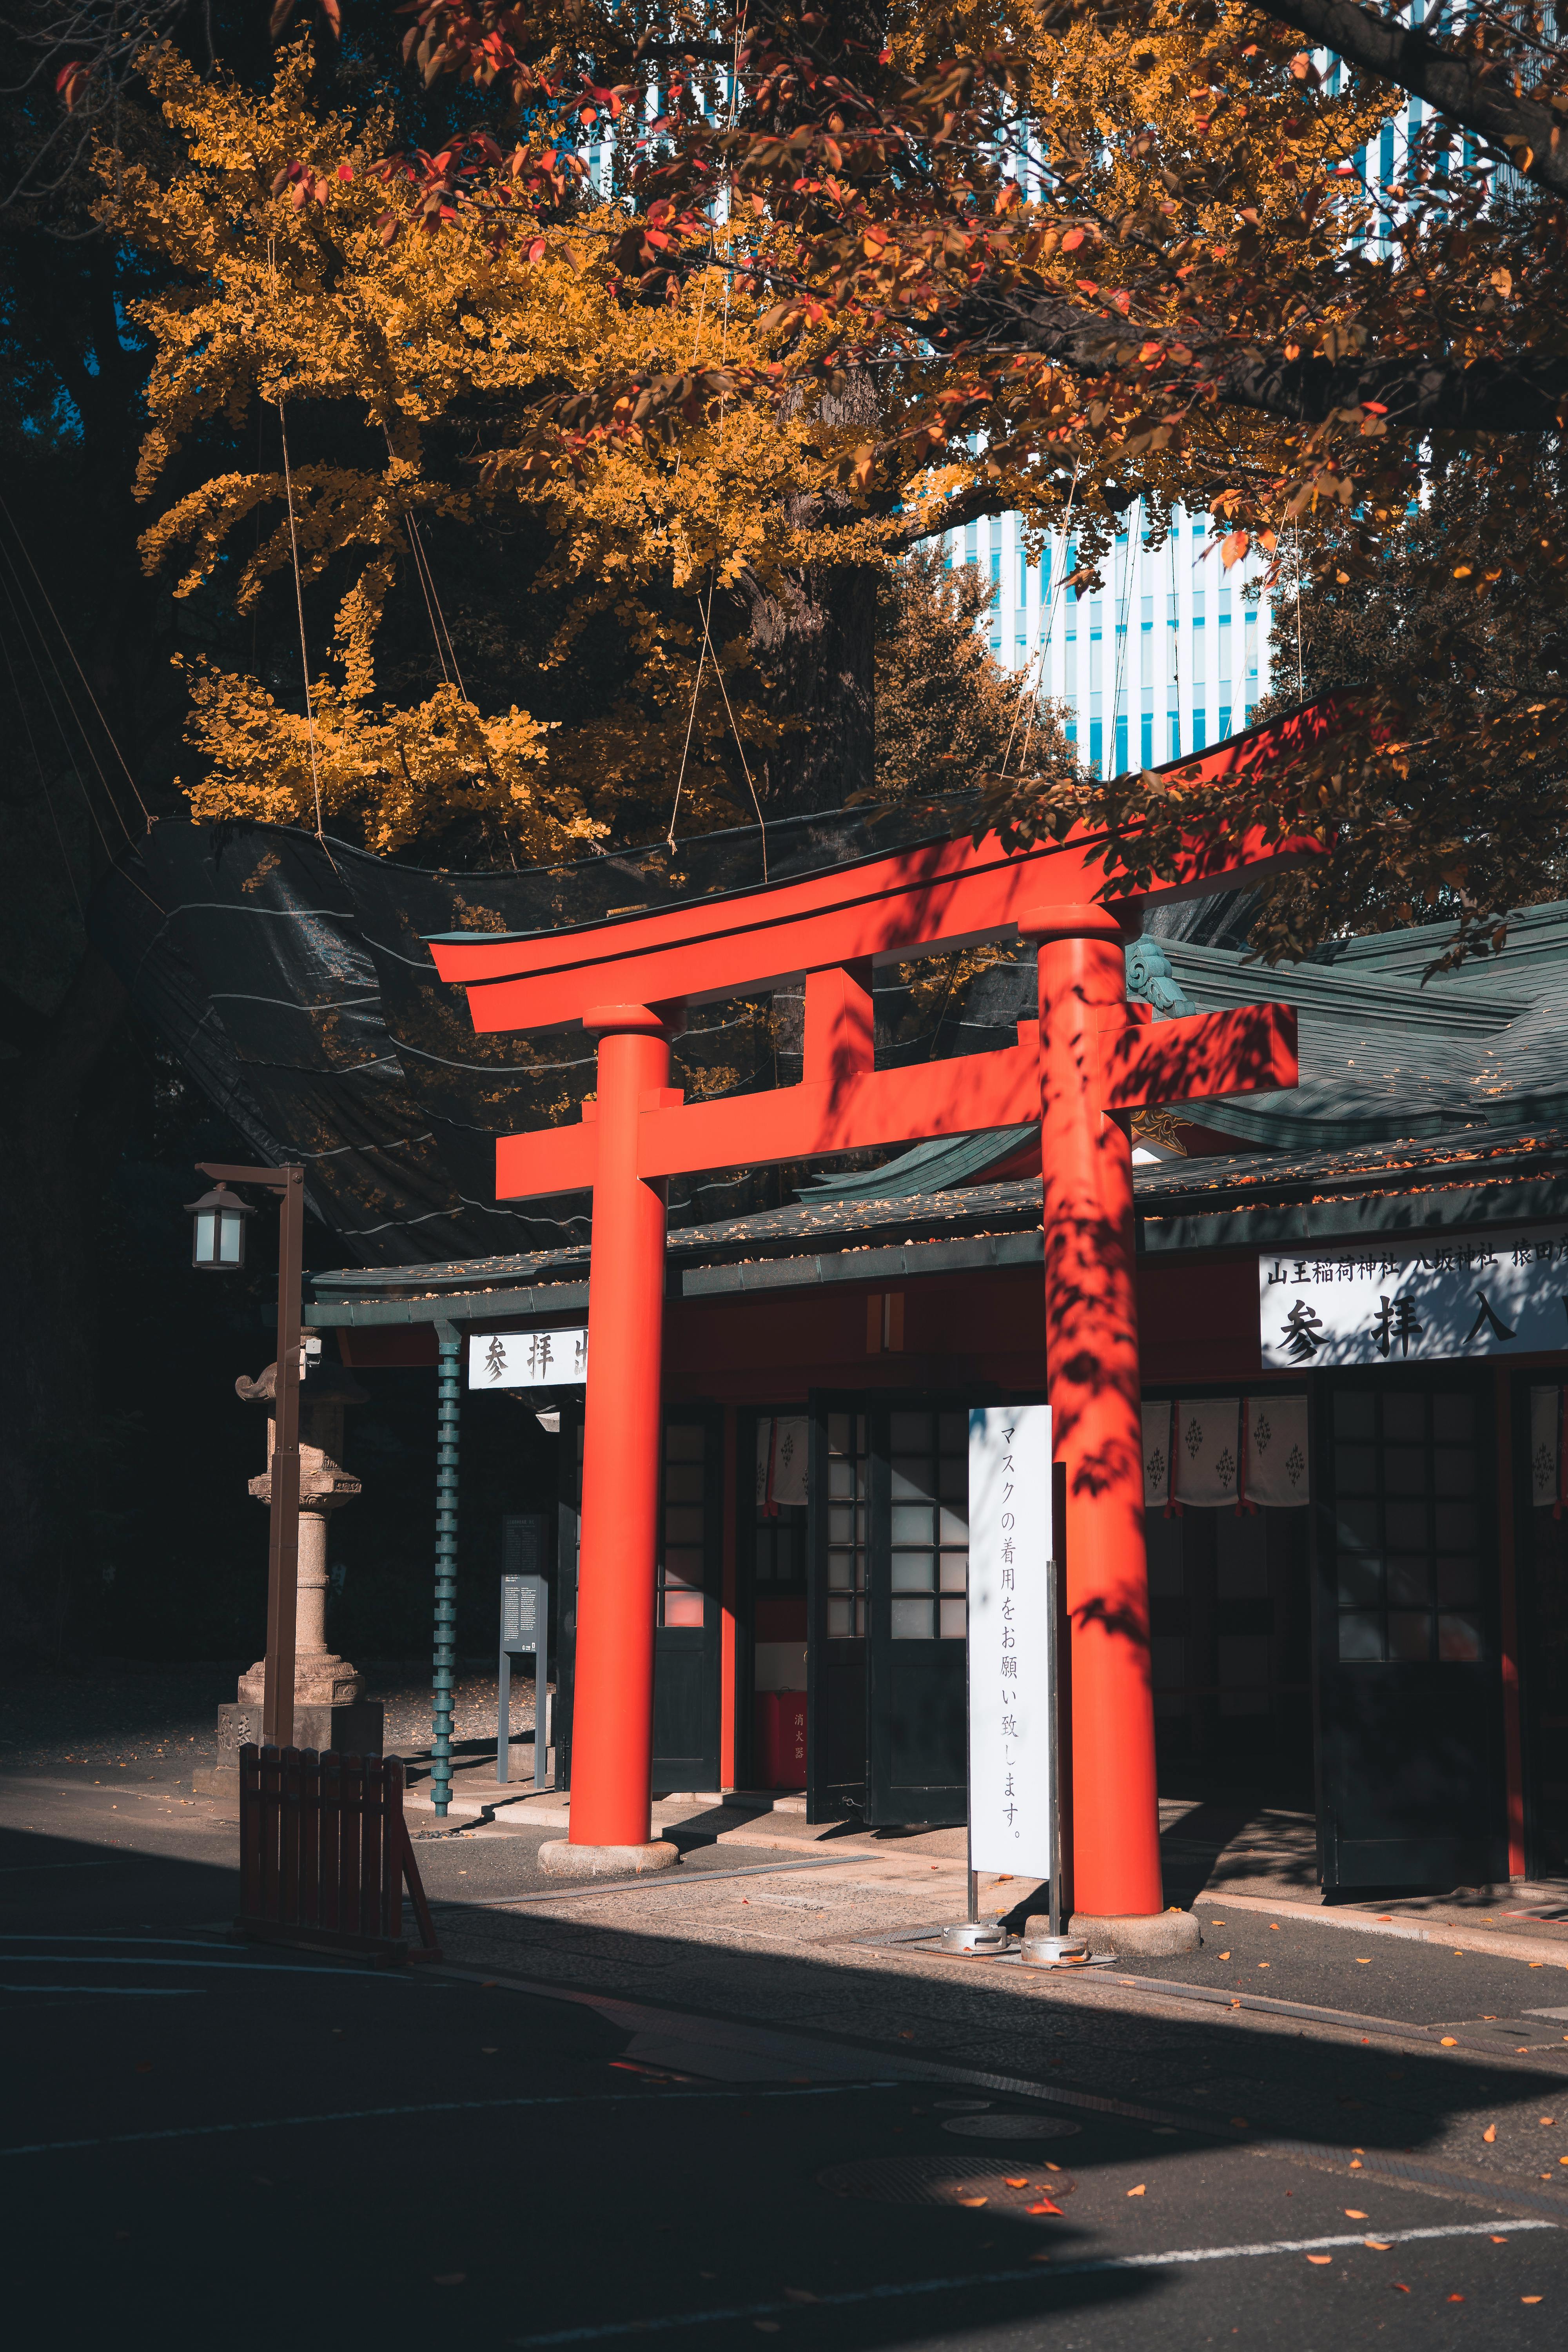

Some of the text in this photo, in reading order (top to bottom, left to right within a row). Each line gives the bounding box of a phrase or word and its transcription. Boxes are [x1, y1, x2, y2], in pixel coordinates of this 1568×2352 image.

[1267, 1252, 1400, 1285] 山王稲荷神社
[1413, 1241, 1499, 1272] 八坂神社
[1275, 1291, 1568, 1366] 参拝入
[1000, 1427, 1020, 1838] マスクの着用をお願い致します。
[794, 1713, 804, 1759] 消火器
